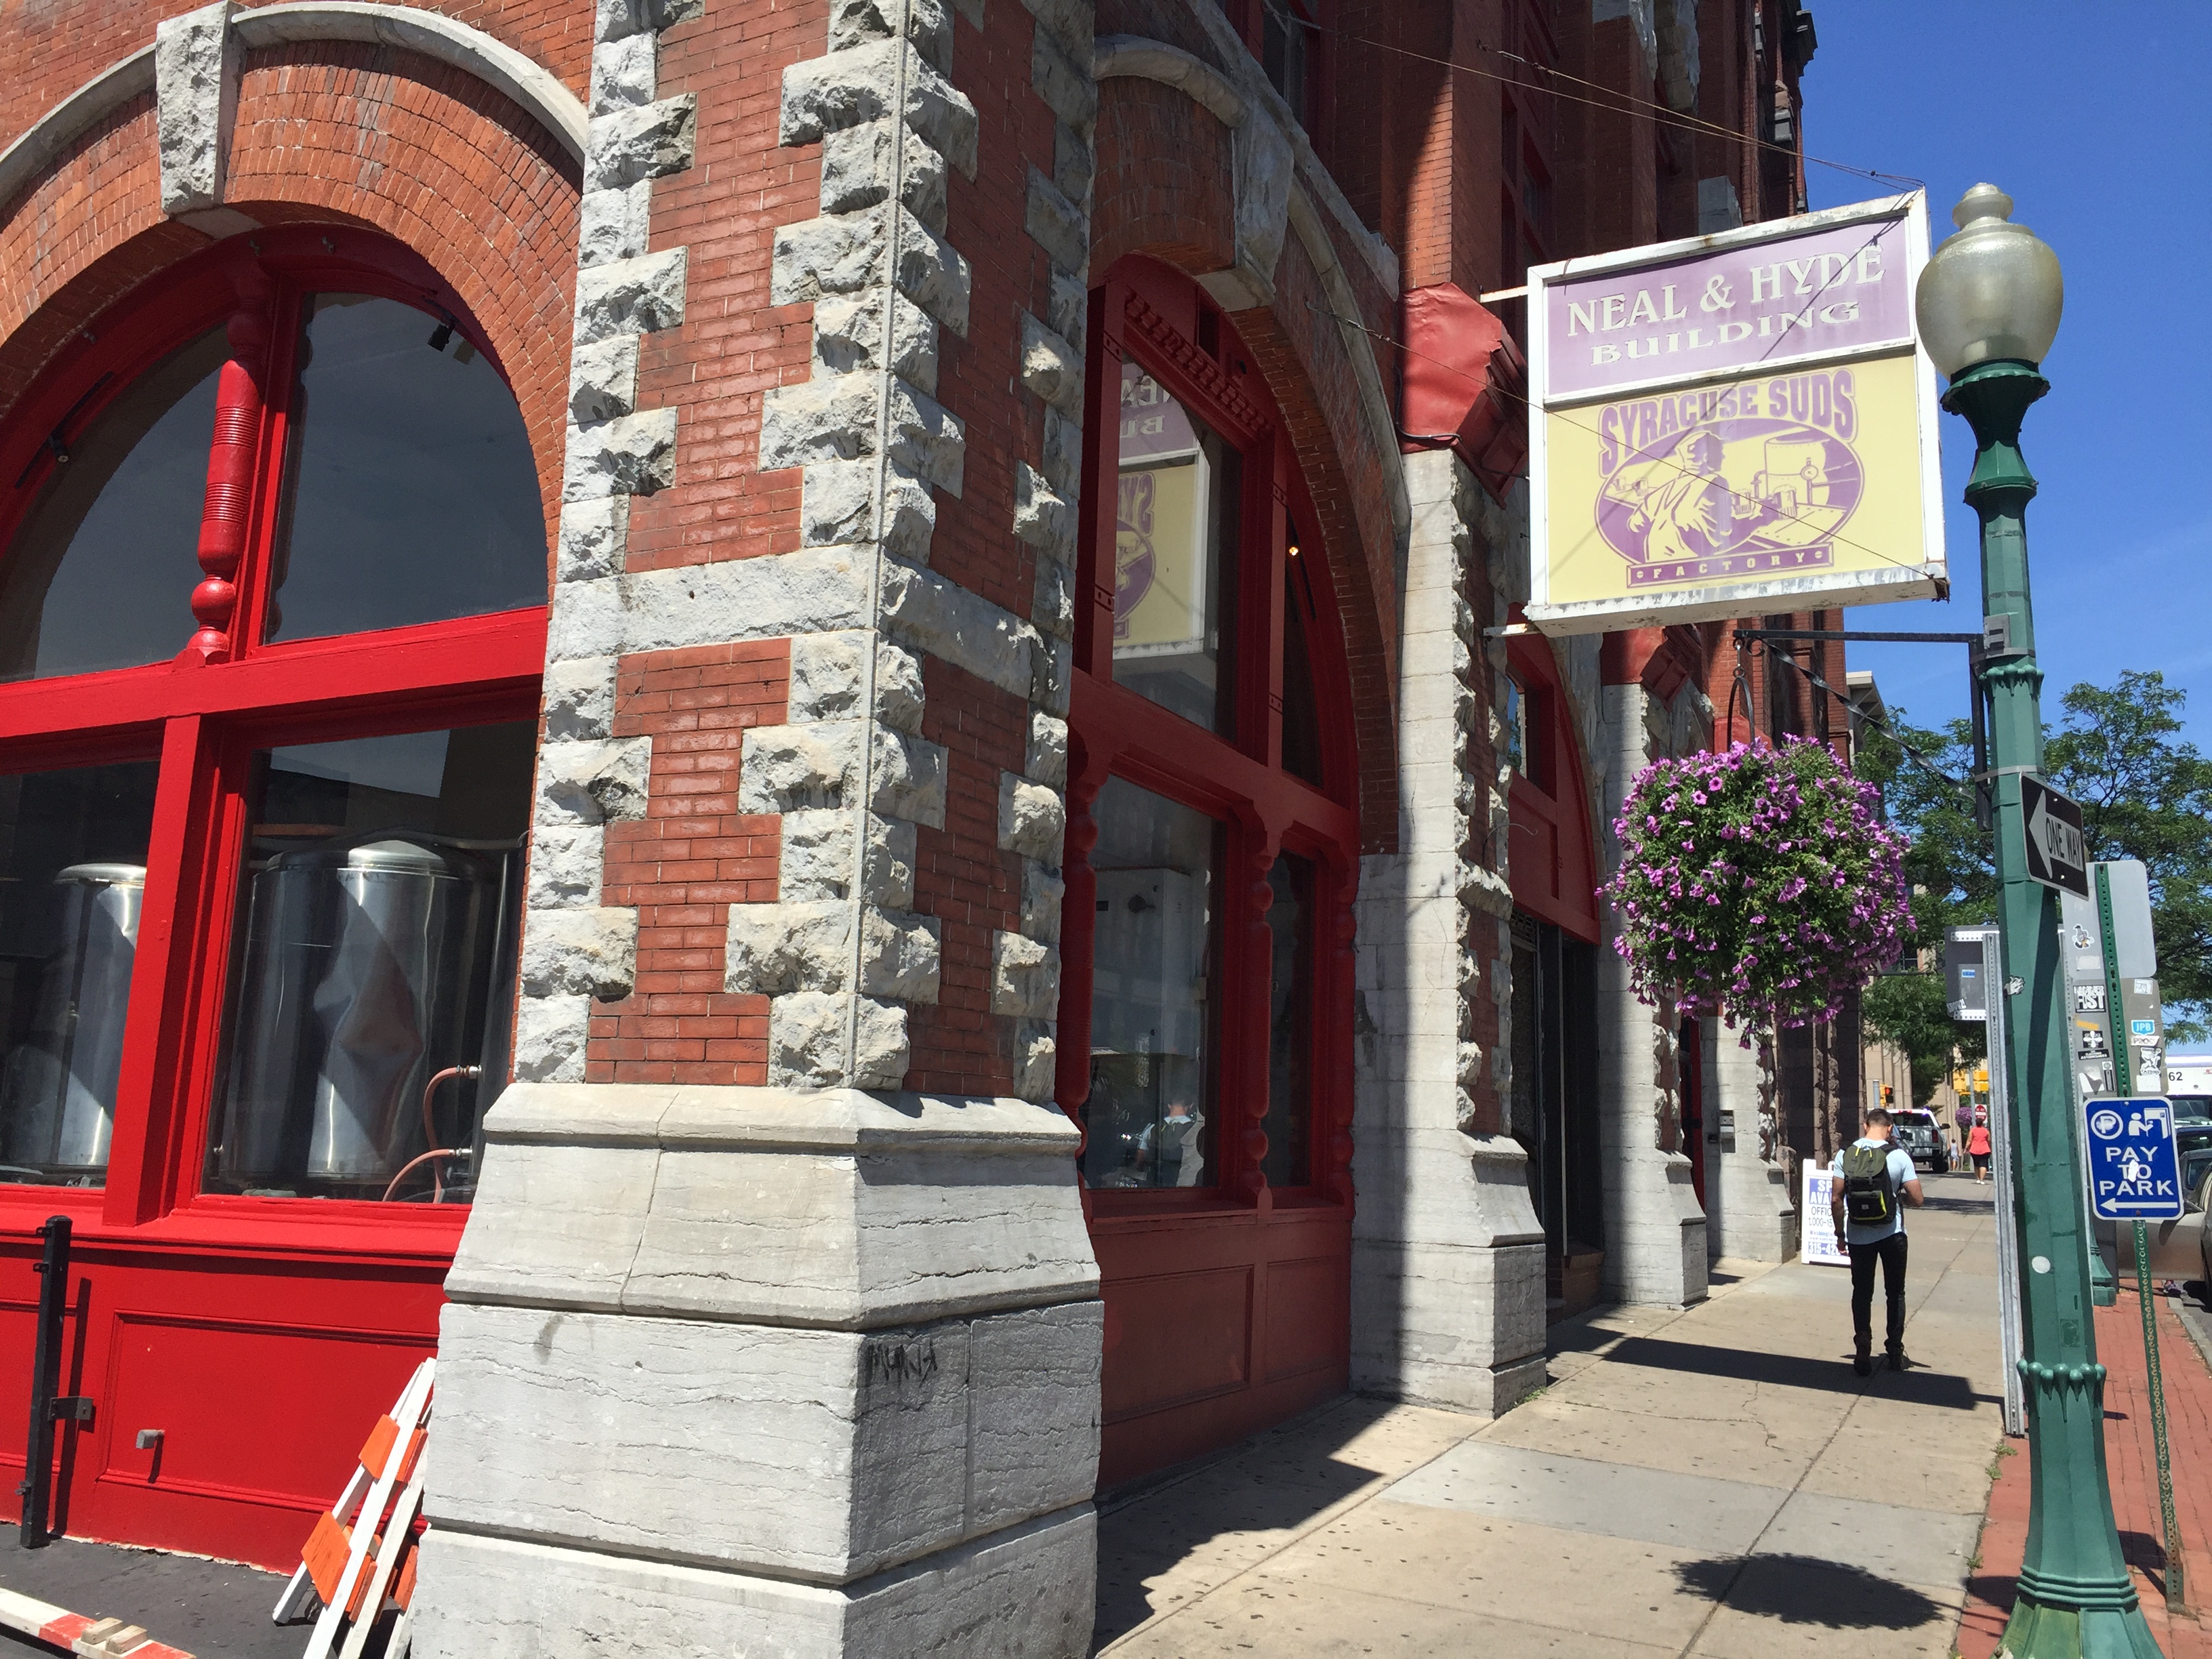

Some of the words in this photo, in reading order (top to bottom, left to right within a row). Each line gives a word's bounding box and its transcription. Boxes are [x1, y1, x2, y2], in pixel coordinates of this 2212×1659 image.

[1568, 283, 1688, 337] NEAL
[1700, 274, 1736, 313] &
[1749, 245, 1887, 304] HYDE
[1590, 300, 1862, 367] BUILDING
[1600, 384, 1759, 476] SYRACUSE
[1768, 369, 1854, 439] SUDS
[1653, 552, 1805, 579] FACTORY
[2045, 816, 2065, 859] ONE
[2065, 827, 2081, 867] WAY
[2136, 1022, 2152, 1031] JPB
[2168, 1071, 2184, 1082] 62
[2105, 1146, 2158, 1162] PAY
[2117, 1164, 2152, 1180] TO
[2099, 1180, 2174, 1196] PARK
[1811, 1206, 1832, 1216] OFFIC
